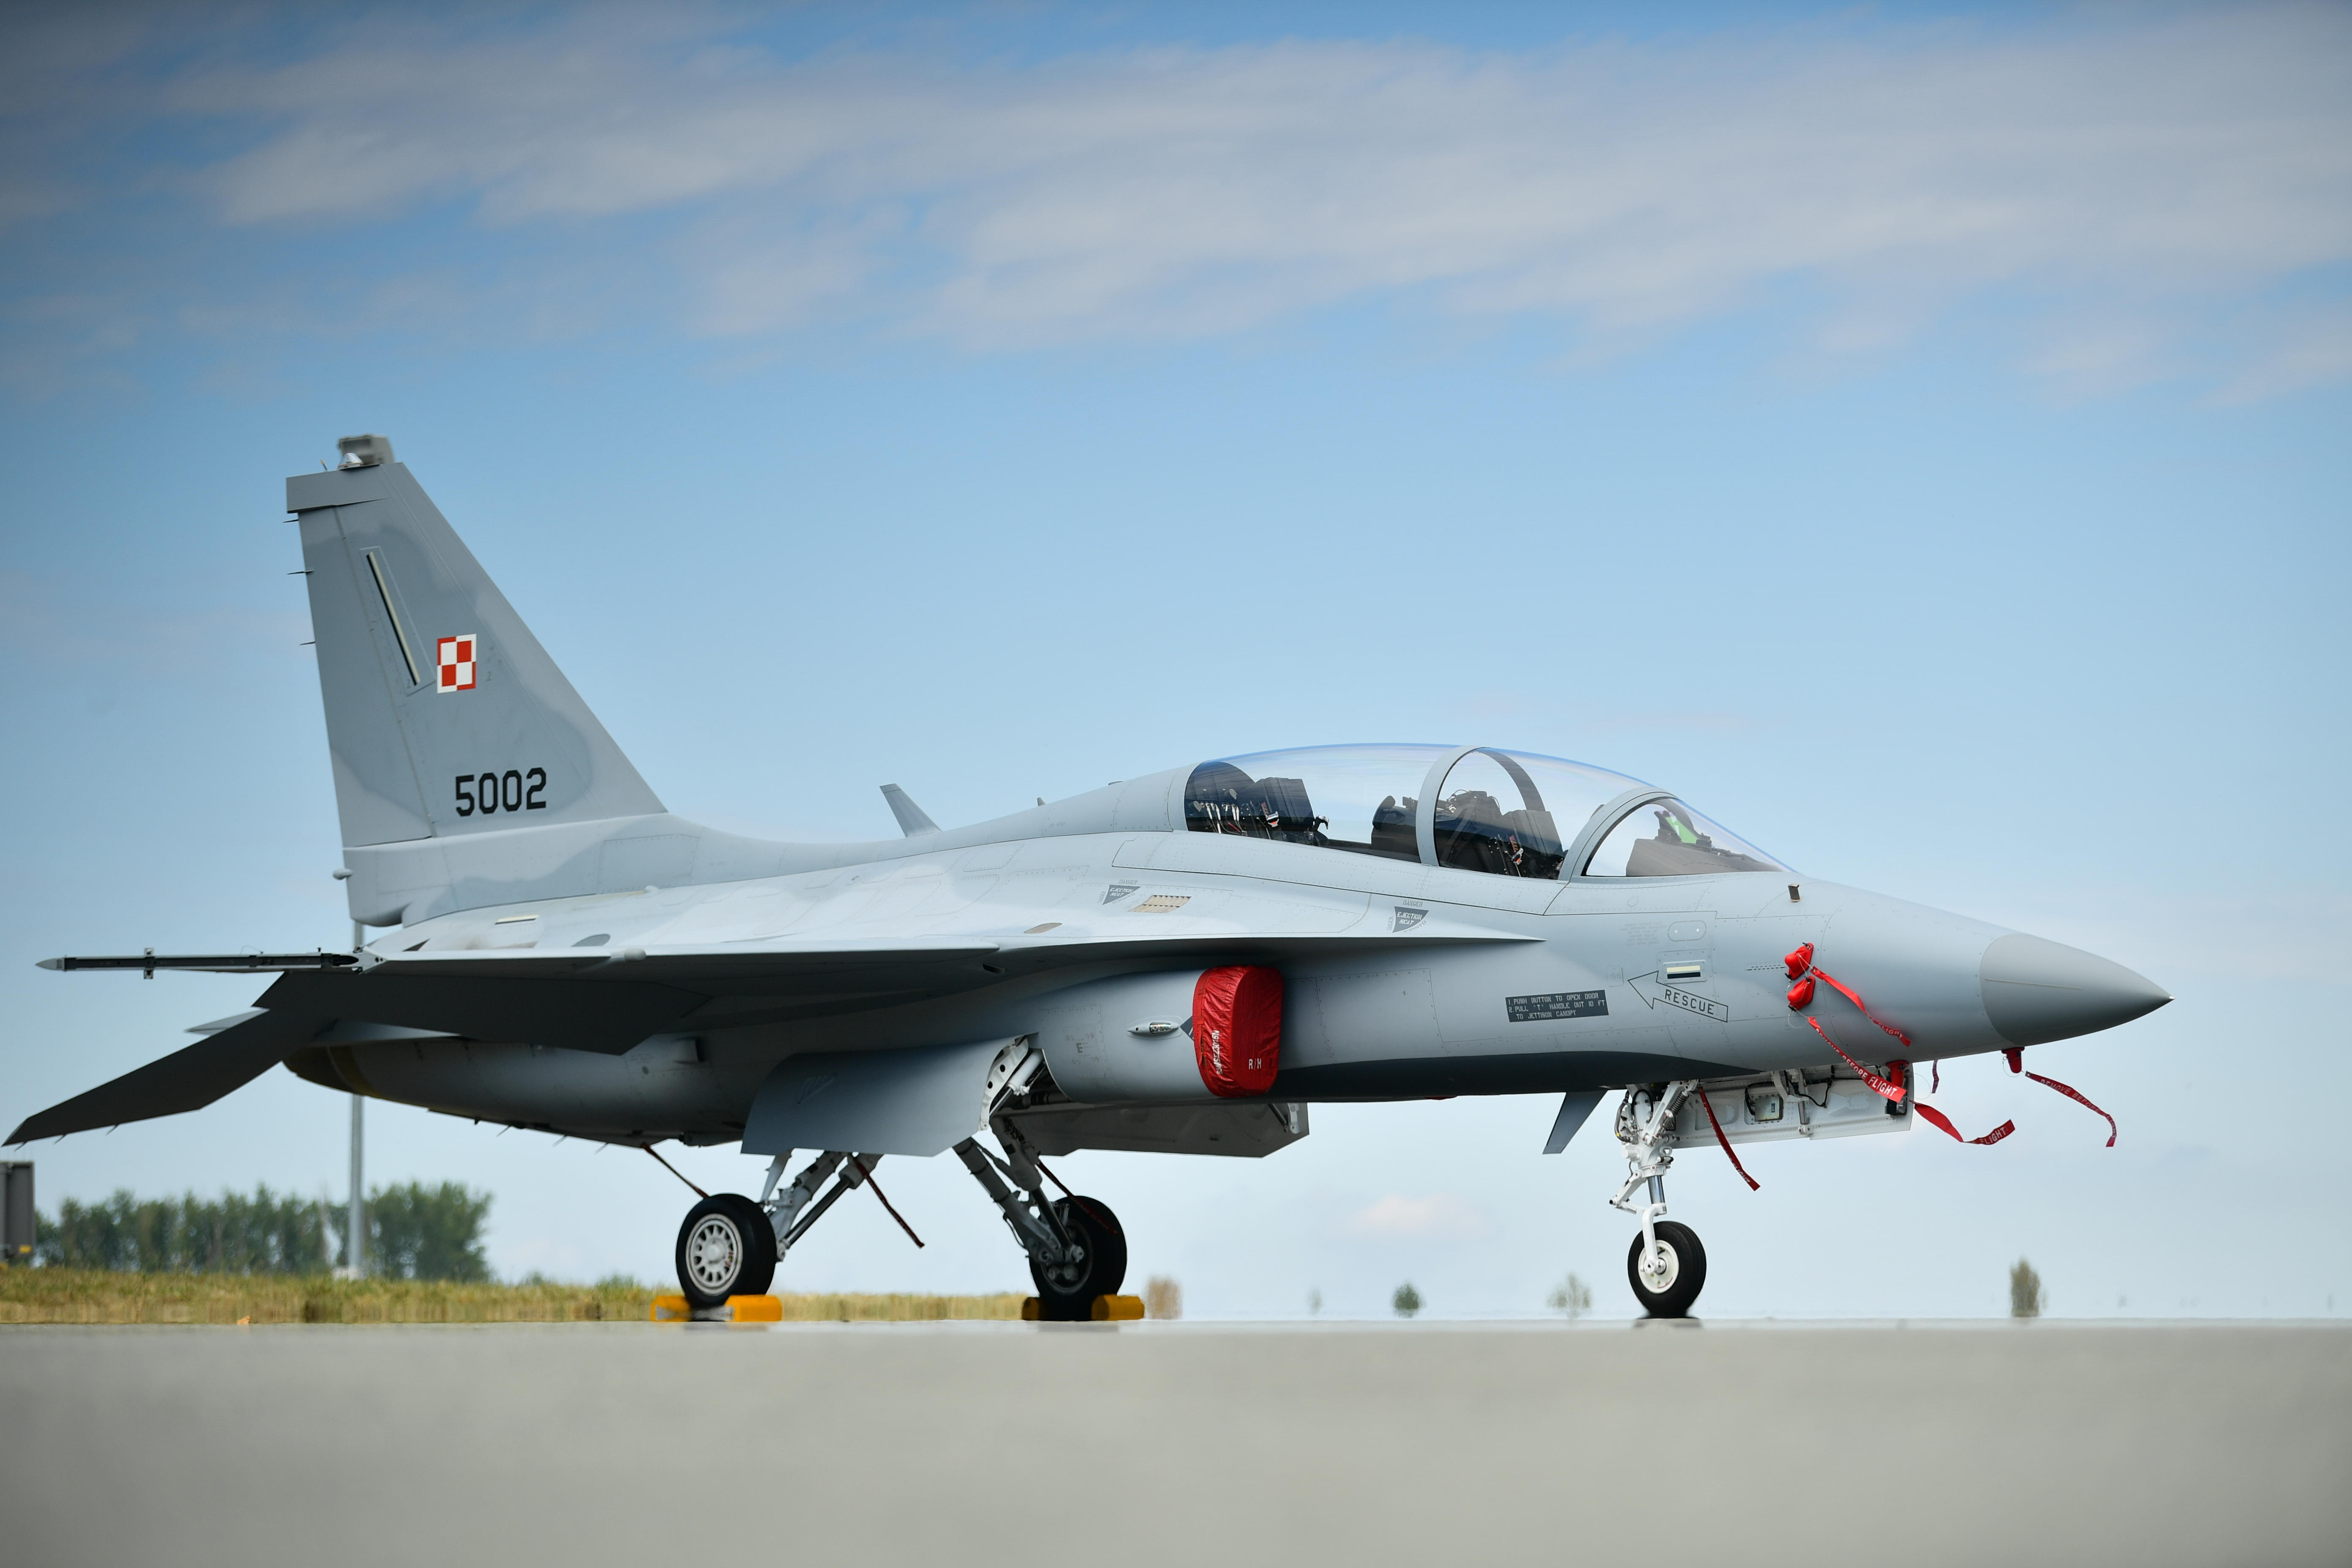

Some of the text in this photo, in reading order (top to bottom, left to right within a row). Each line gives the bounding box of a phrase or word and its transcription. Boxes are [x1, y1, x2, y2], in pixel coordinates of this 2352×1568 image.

[456, 767, 546, 817] 5002
[1403, 899, 1423, 907] DANGER
[1396, 912, 1422, 920] EJECTION
[1665, 989, 1714, 1015] RESCUE
[1528, 1011, 1552, 1019] JETTISON
[1249, 1058, 1262, 1070] R/H
[1868, 1076, 1897, 1097] FLIGHT
[1979, 1127, 2006, 1144] FLIGHT
